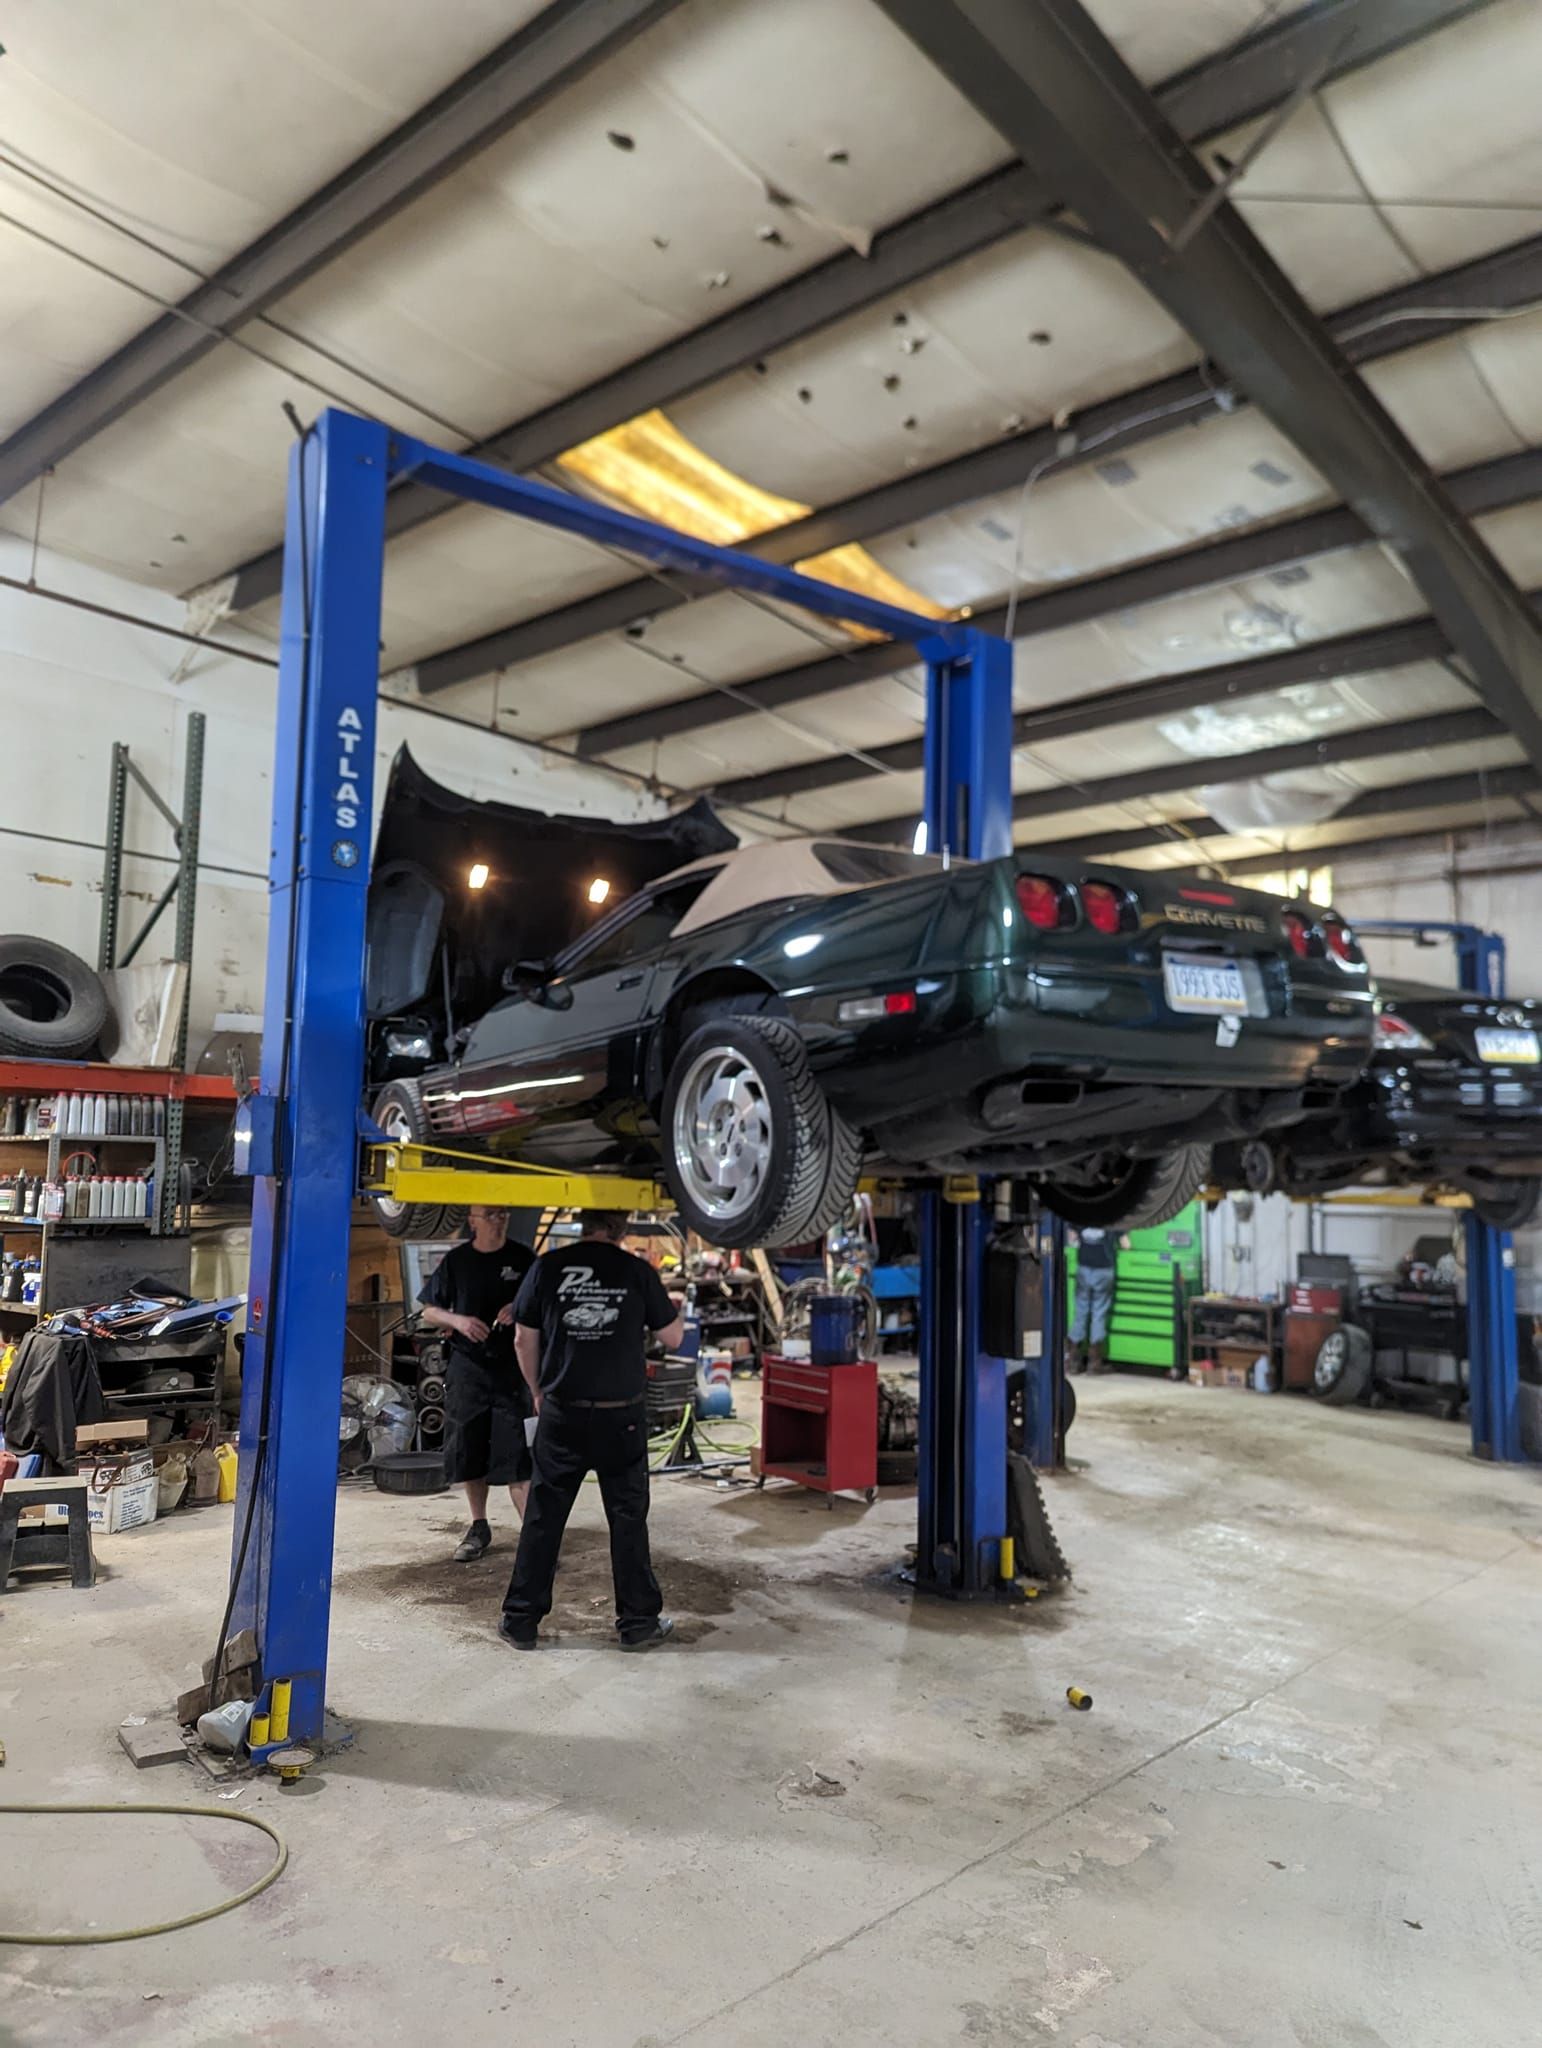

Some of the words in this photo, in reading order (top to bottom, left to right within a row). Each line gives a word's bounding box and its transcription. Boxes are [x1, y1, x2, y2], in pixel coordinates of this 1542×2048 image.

[336, 706, 363, 829] ATLAS
[1164, 904, 1267, 933] CORVETTE
[1172, 966, 1209, 998] 1993
